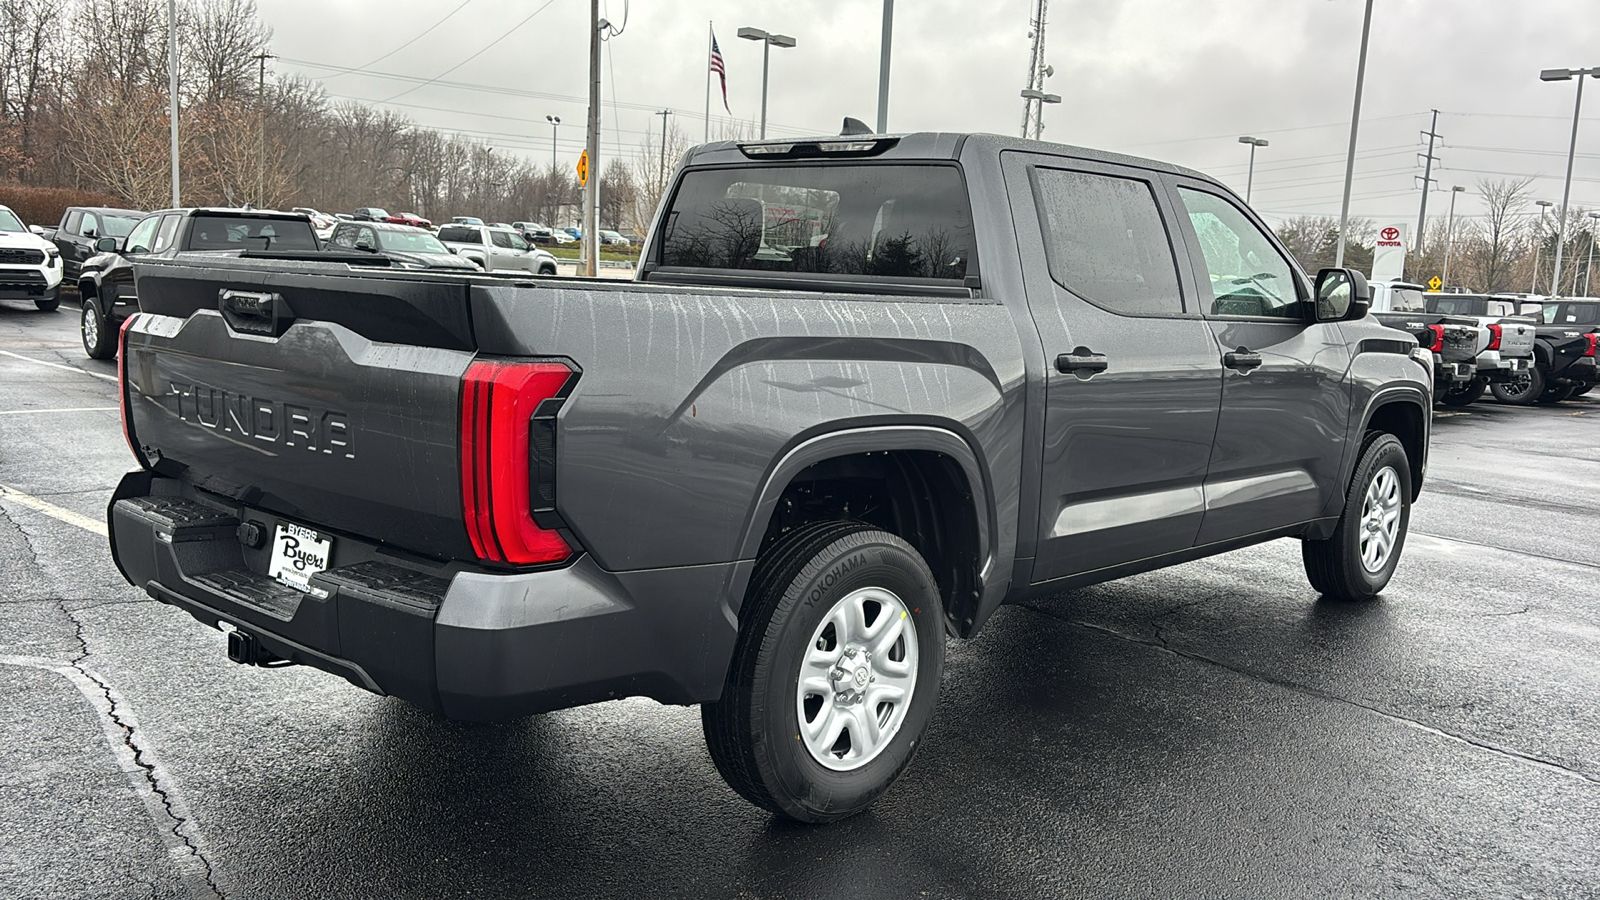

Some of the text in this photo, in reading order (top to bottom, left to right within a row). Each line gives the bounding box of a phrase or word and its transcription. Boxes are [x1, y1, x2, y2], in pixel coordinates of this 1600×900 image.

[170, 381, 355, 459] TUNDRA
[280, 535, 323, 571] Byers
[288, 523, 318, 541] BYERS
[804, 553, 867, 608] YOKOHAMA
